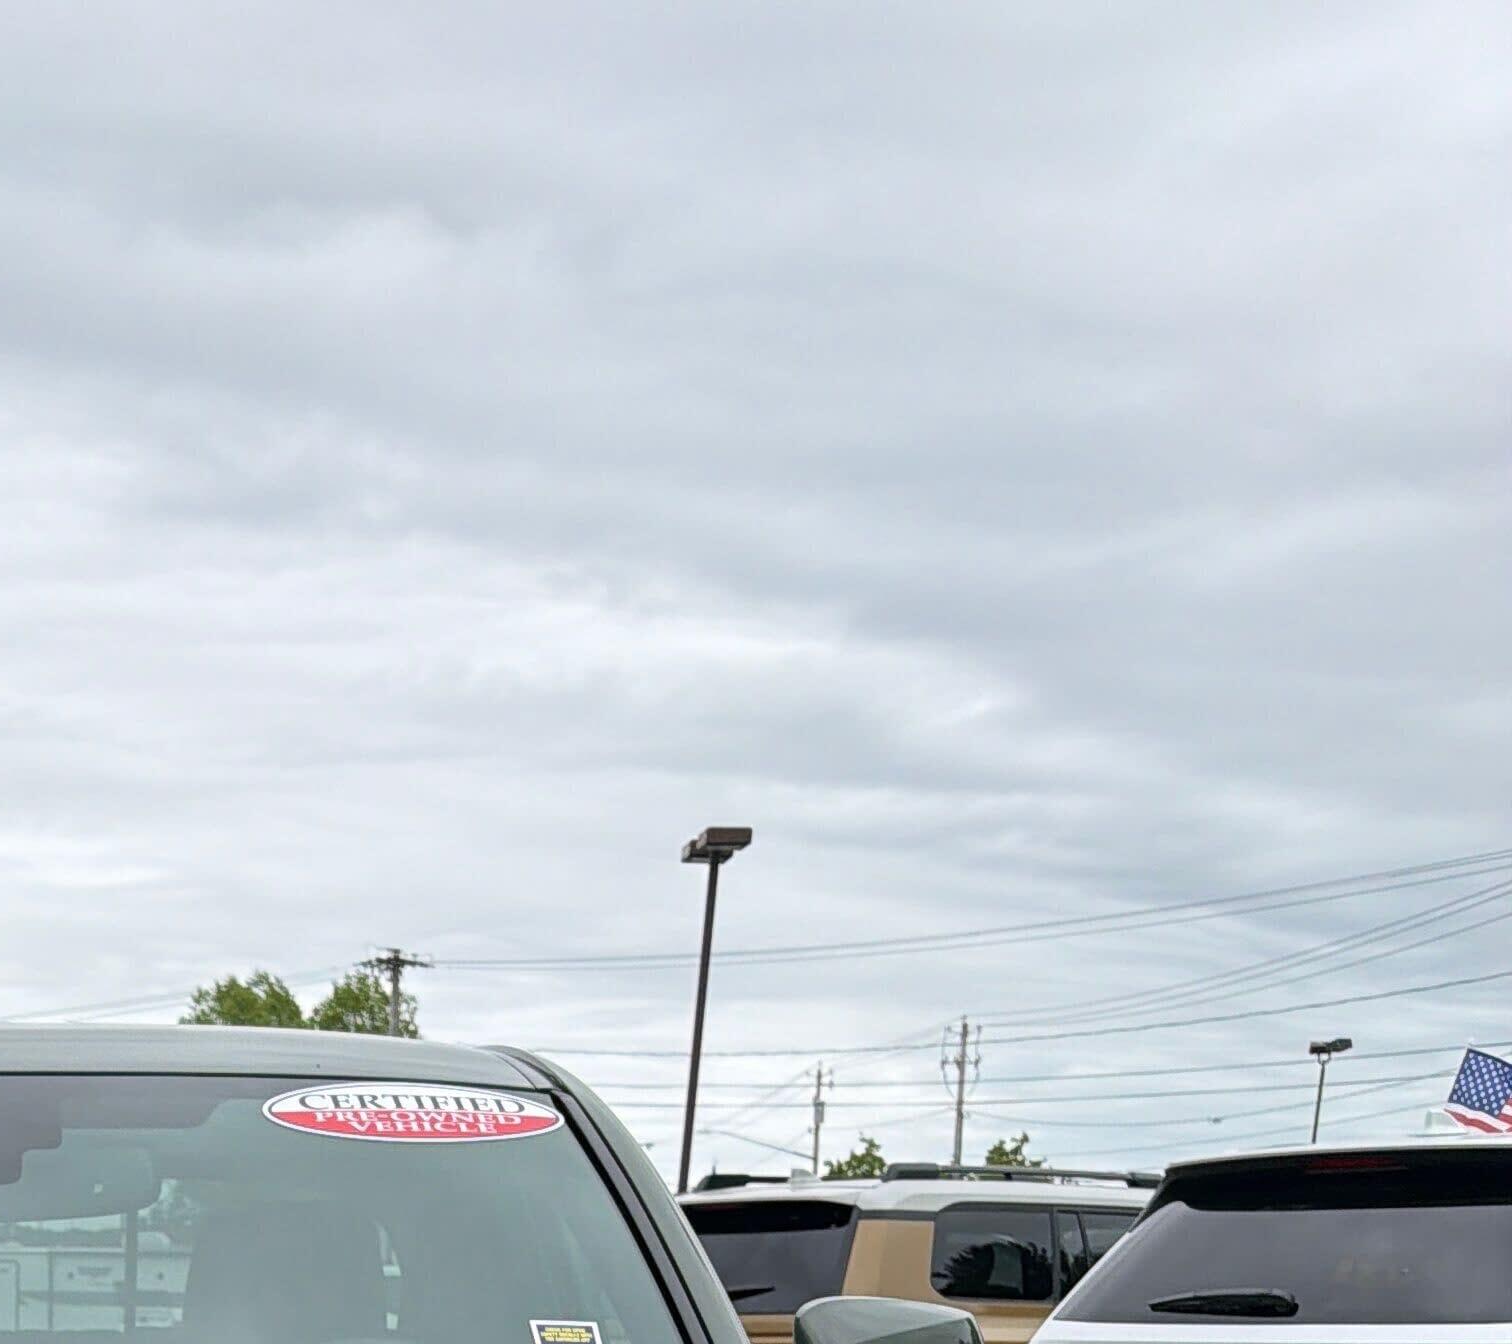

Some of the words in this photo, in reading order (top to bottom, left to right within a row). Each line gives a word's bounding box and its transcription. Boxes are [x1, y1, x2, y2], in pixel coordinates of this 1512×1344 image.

[299, 1093, 526, 1114] CERTIFIED
[314, 1110, 522, 1126] PRE-OWNED
[350, 1120, 498, 1135] VEHICLE
